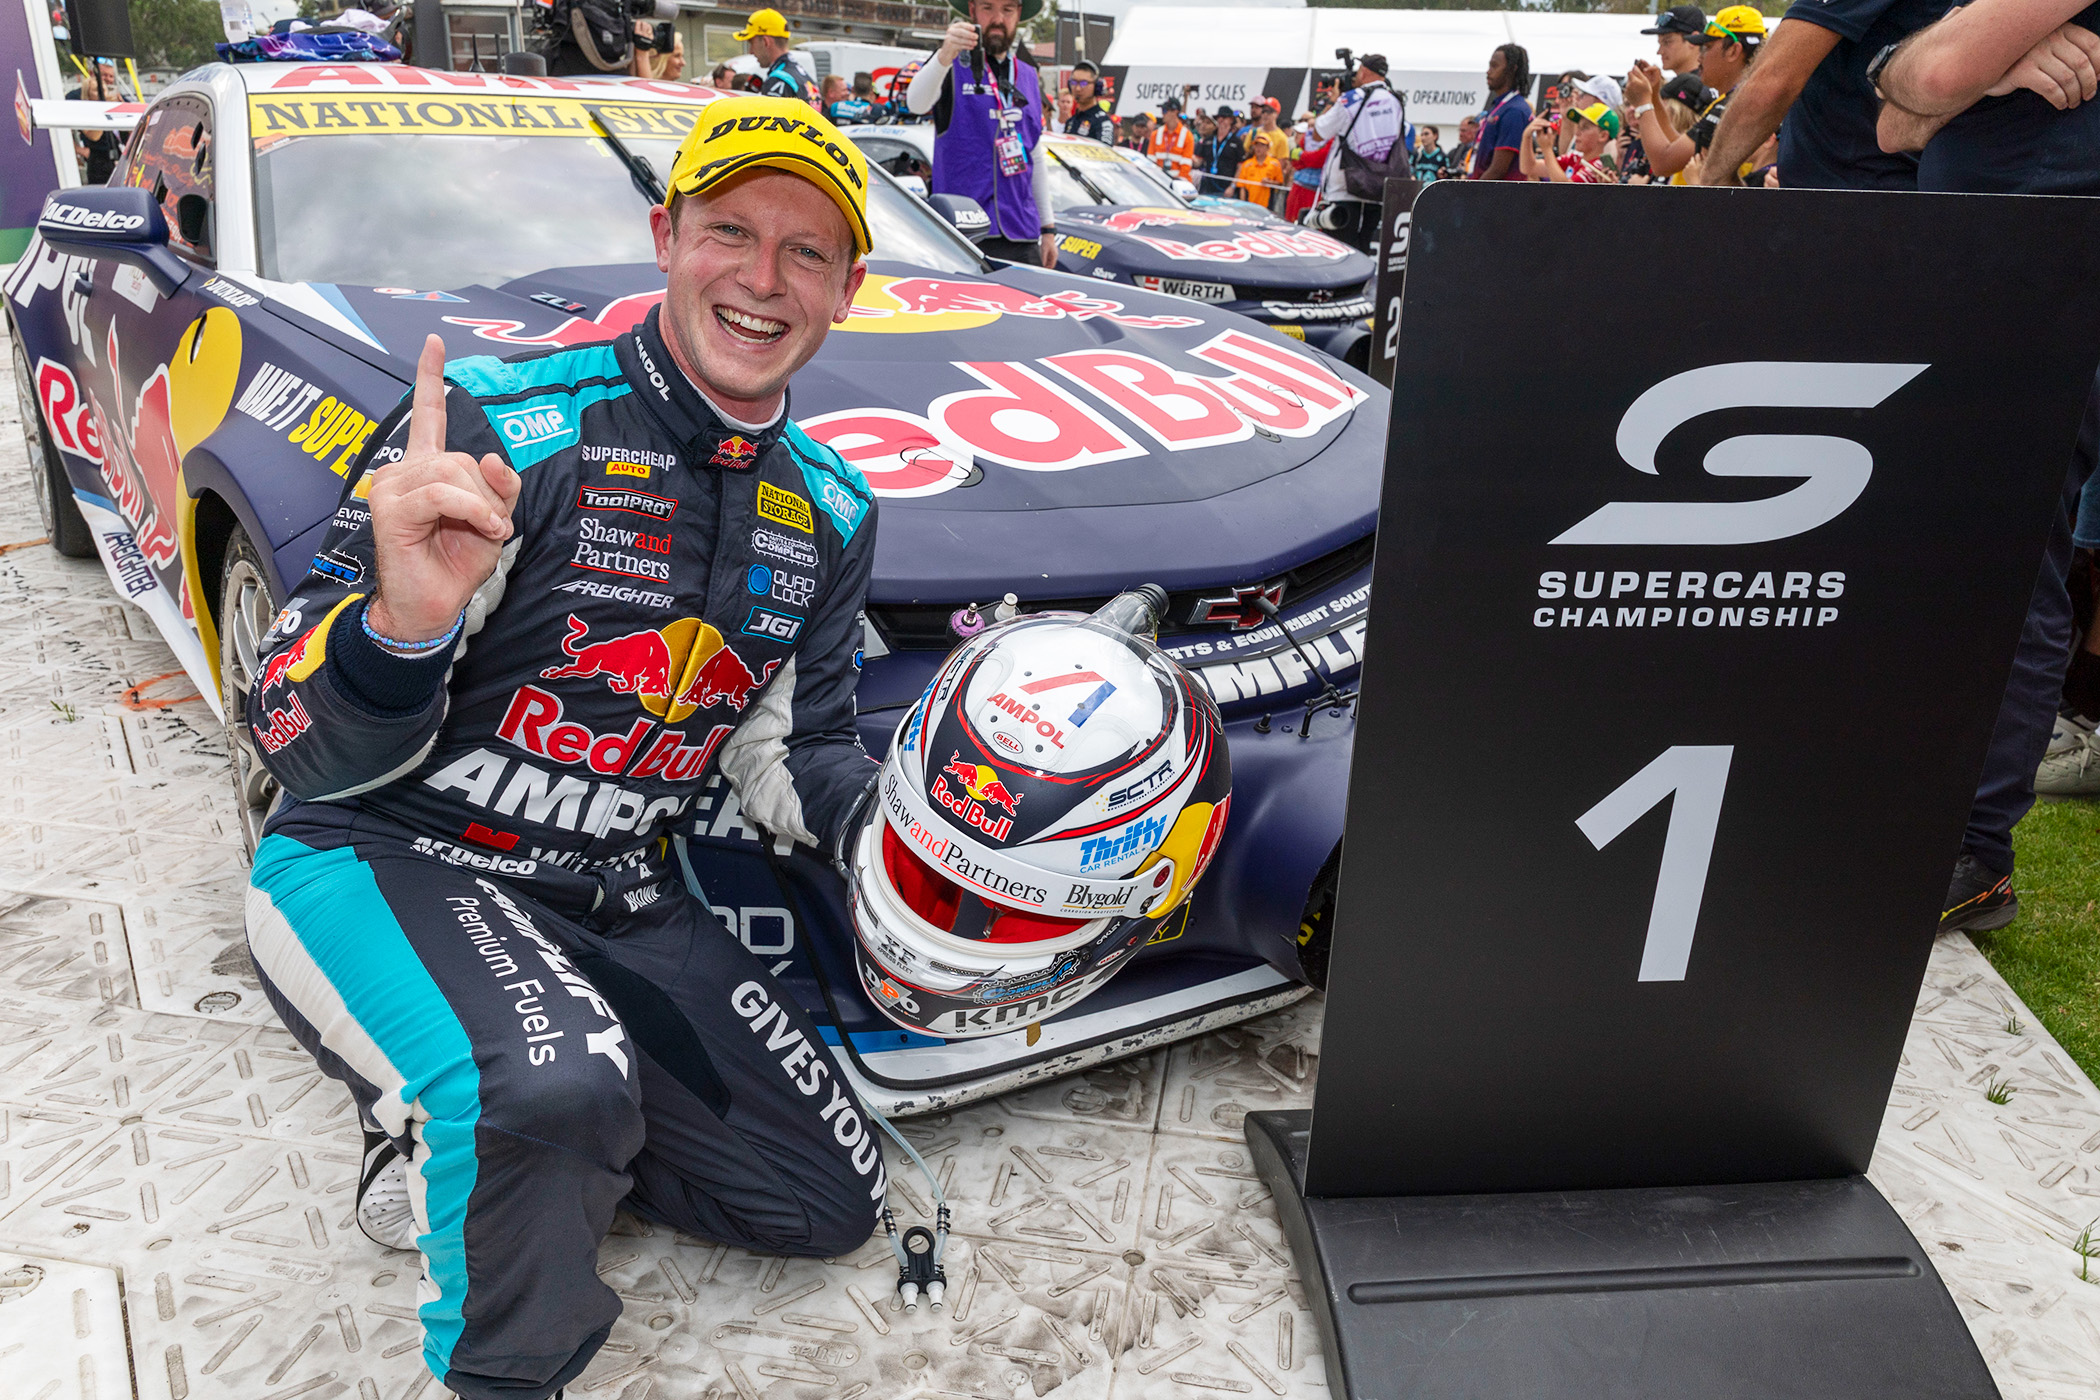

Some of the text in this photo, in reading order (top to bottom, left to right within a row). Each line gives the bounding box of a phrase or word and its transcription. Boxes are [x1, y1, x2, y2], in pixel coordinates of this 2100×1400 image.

[271, 66, 742, 101] AMPO
[1136, 83, 1246, 100] SUPERCS SCALES
[1412, 90, 1477, 105] OPERATIONS
[256, 103, 700, 136] NATIONAL STO
[704, 116, 863, 190] DUNLOP
[42, 203, 145, 230] ACDelco
[1060, 236, 1103, 260] SUPER
[207, 279, 259, 308] DUNLOP
[1163, 280, 1225, 300] WÜRTH
[264, 382, 324, 432] IT
[287, 395, 380, 480] SUPE
[503, 410, 566, 443] OMP
[581, 444, 677, 472] SUPERCHEAP
[610, 463, 646, 475] AUTO
[761, 485, 809, 514] NATIONAL
[763, 500, 809, 527] STORAGE
[823, 483, 857, 521] OMP
[103, 531, 159, 599] FREIGHTER
[570, 541, 671, 579] Partners
[560, 580, 675, 609] FREIGHTER
[771, 583, 811, 608] LOCK
[773, 569, 816, 593] QUAD
[1537, 571, 1847, 599] SUPERCARS
[749, 613, 801, 639] JGI
[1216, 639, 1233, 652] &
[1231, 608, 1329, 650] EQUIPMENT
[1533, 607, 1840, 627] CHAMPIONSHIP
[495, 684, 737, 781] Red Bull
[987, 692, 1066, 750] AMPOL
[996, 733, 1020, 752] BELL
[424, 748, 693, 840] AMPO
[1107, 759, 1174, 808] SCTR
[930, 773, 1014, 843] Red Bull
[1080, 814, 1168, 867] Thrifty
[1080, 848, 1141, 874] CAR RENTAL
[1575, 745, 1734, 982] 1
[1064, 883, 1135, 909] Blygold
[1096, 921, 1121, 946] OAKLEY
[446, 896, 565, 1067] Premium Fuels
[731, 980, 829, 1096] GIVES
[819, 1079, 878, 1176] YOU
